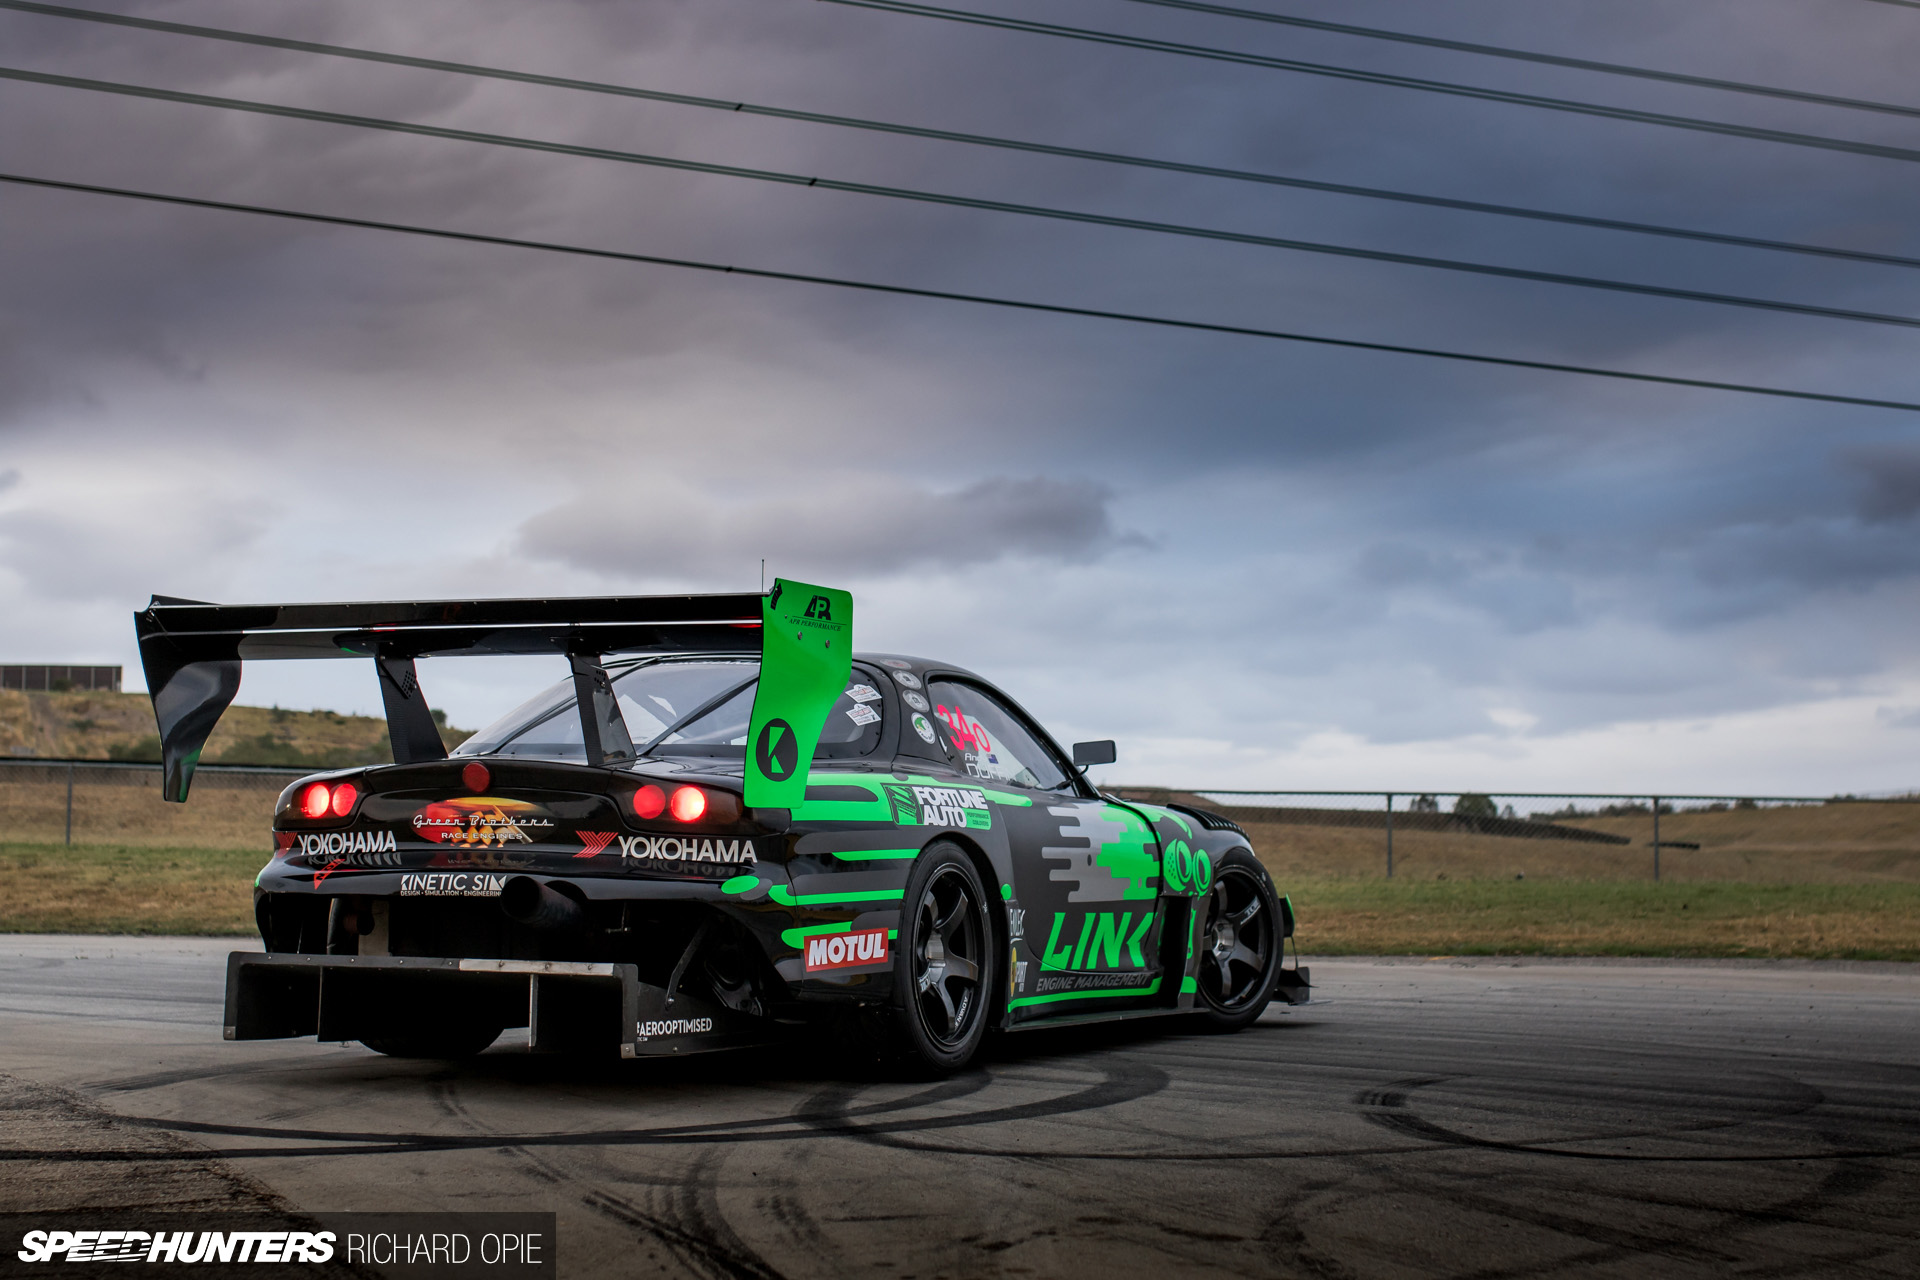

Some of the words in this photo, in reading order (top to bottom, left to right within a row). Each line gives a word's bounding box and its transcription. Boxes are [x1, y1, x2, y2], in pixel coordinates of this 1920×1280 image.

[800, 620, 841, 631] PERFORMANCE
[937, 704, 991, 752] 340
[912, 786, 989, 810] FORTUNE
[413, 814, 465, 828] Green
[469, 814, 554, 827] Brothers
[923, 804, 968, 828] AUTO
[297, 830, 397, 856] YOKOHAMA
[473, 832, 523, 840] ENGINES
[618, 835, 758, 863] YOKOHAMA
[400, 874, 468, 890] KINETIC
[808, 932, 885, 967] MOTUL
[1040, 912, 1159, 972] LINK
[1036, 976, 1076, 992] ENGINE
[1073, 974, 1150, 990] MANAGEMENT
